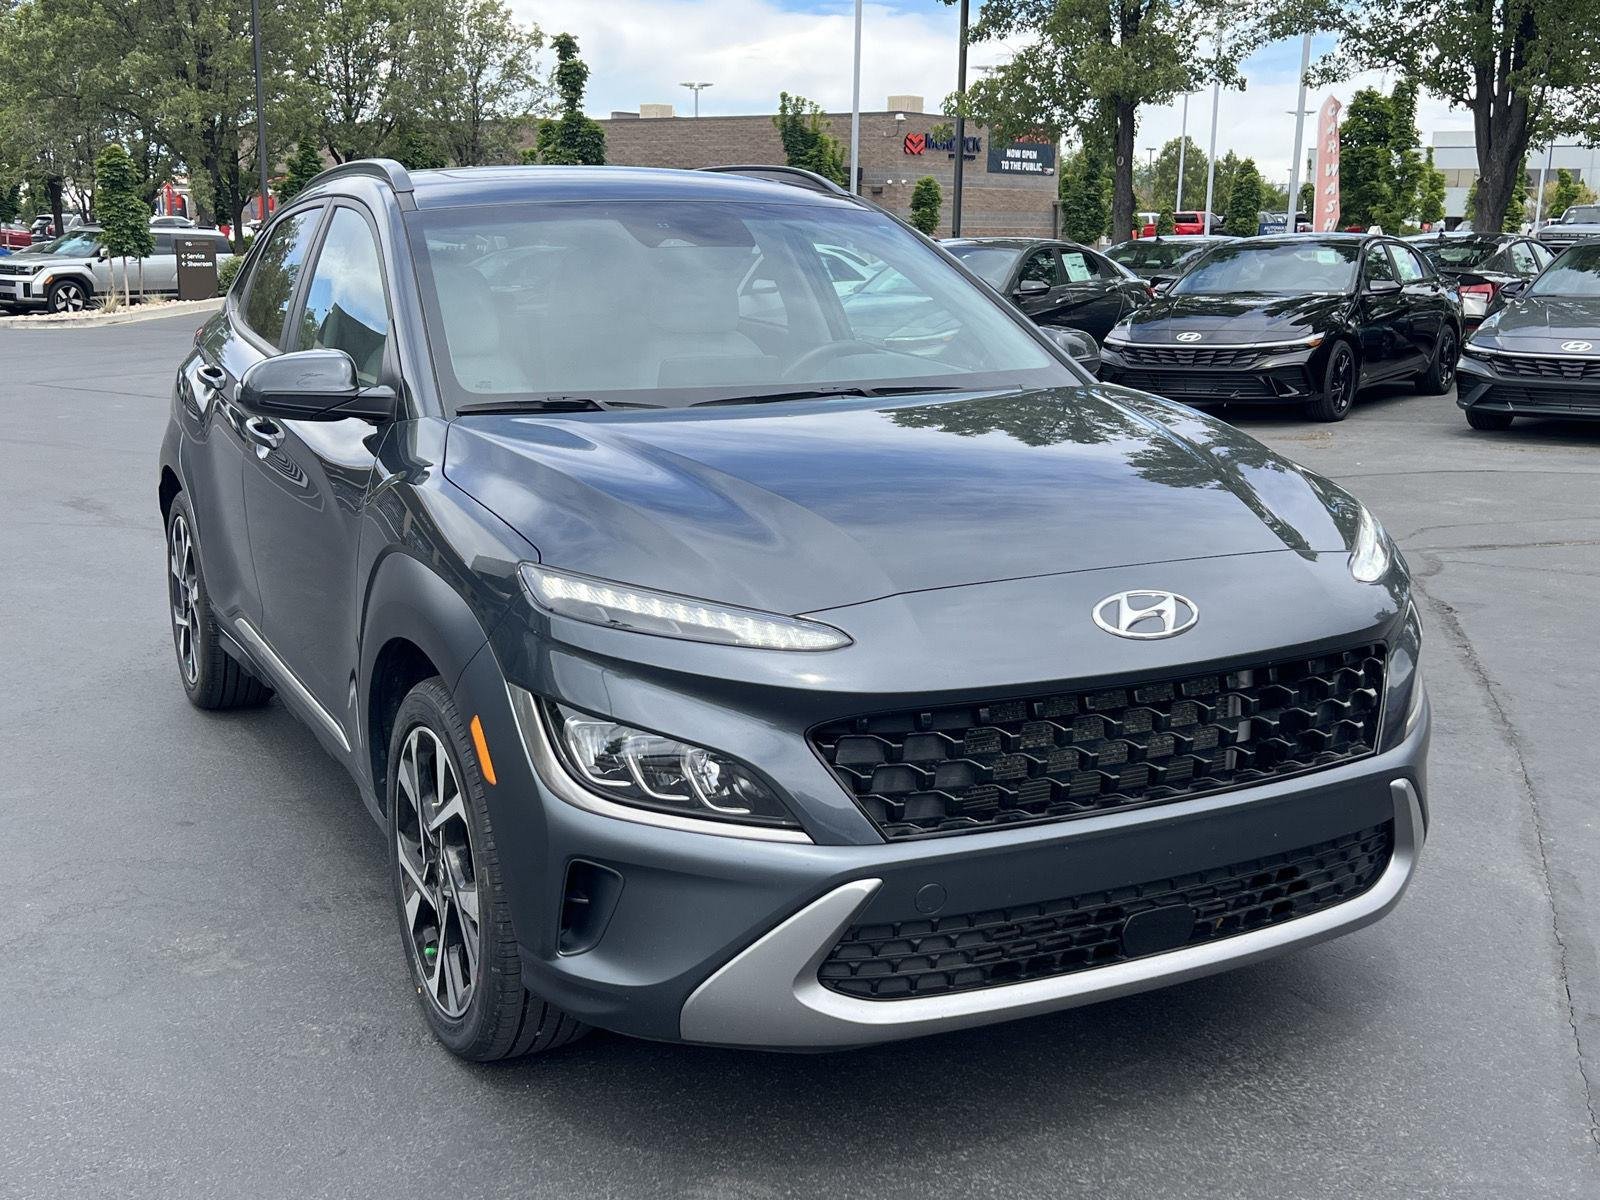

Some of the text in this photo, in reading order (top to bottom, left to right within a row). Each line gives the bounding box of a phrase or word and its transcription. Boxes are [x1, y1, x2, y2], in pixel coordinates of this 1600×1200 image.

[1006, 148, 1038, 159] NOW OPEN
[1001, 160, 1010, 170] TO
[1010, 161, 1021, 170] THE
[1022, 161, 1043, 171] PUBLIC
[1323, 162, 1339, 232] WASH
[186, 260, 213, 268] Showroom
